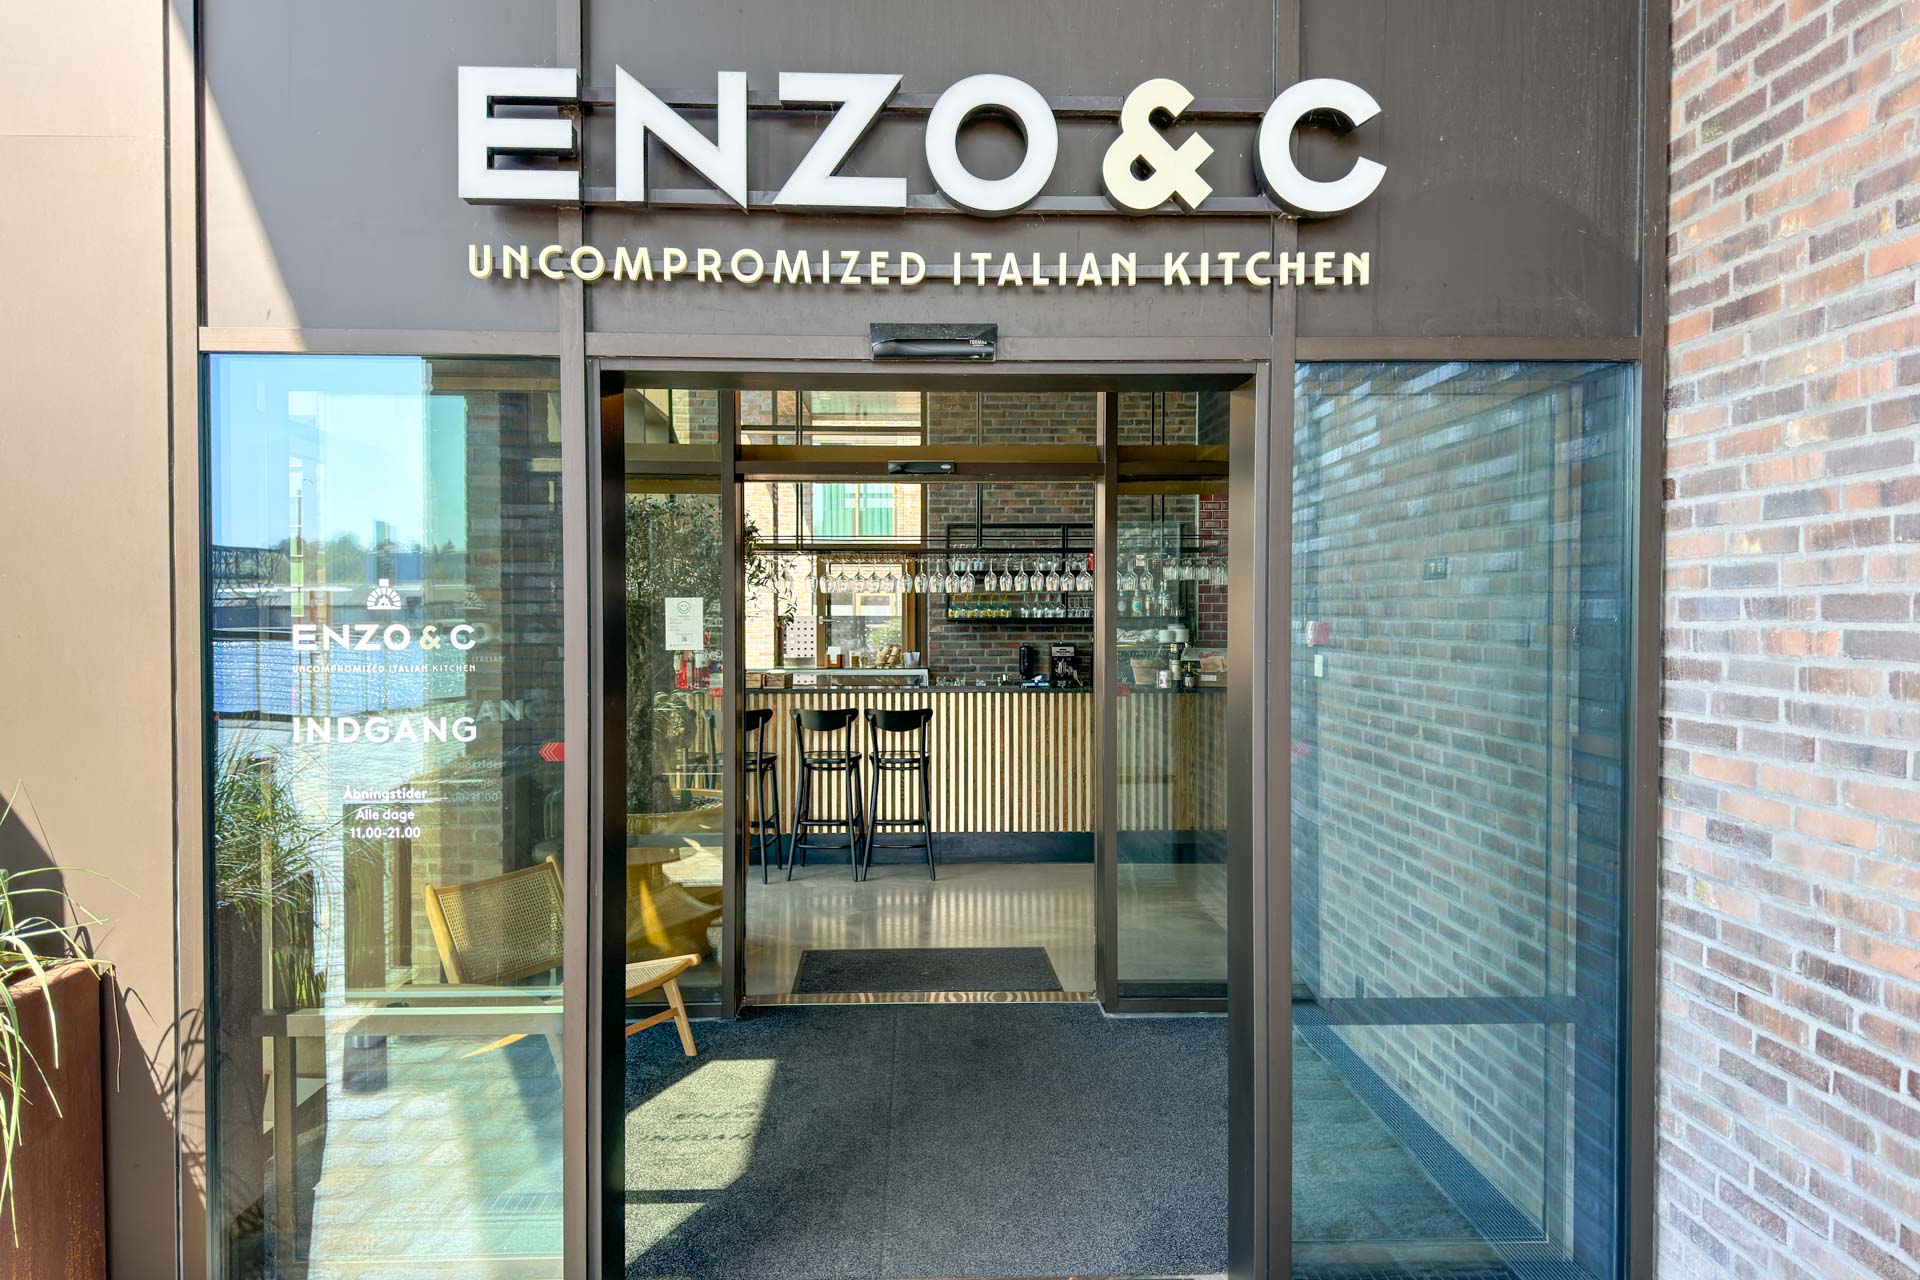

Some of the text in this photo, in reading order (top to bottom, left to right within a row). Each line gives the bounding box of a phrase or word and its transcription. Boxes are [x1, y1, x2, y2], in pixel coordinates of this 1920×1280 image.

[458, 64, 1387, 215] ENZO & C
[468, 244, 1370, 288] UNCOMPROMIZED ITALIAN KITCHEN
[292, 623, 411, 651] ENZO
[419, 625, 442, 650] &
[450, 624, 477, 651] C
[292, 663, 477, 674] UNCOMPROMIZED ITALIAN KITCHEN
[292, 716, 477, 744] INDGANG
[342, 784, 428, 802] Åbningstider
[355, 808, 416, 824] Alle dage
[349, 826, 421, 839] 11.00-21.00
